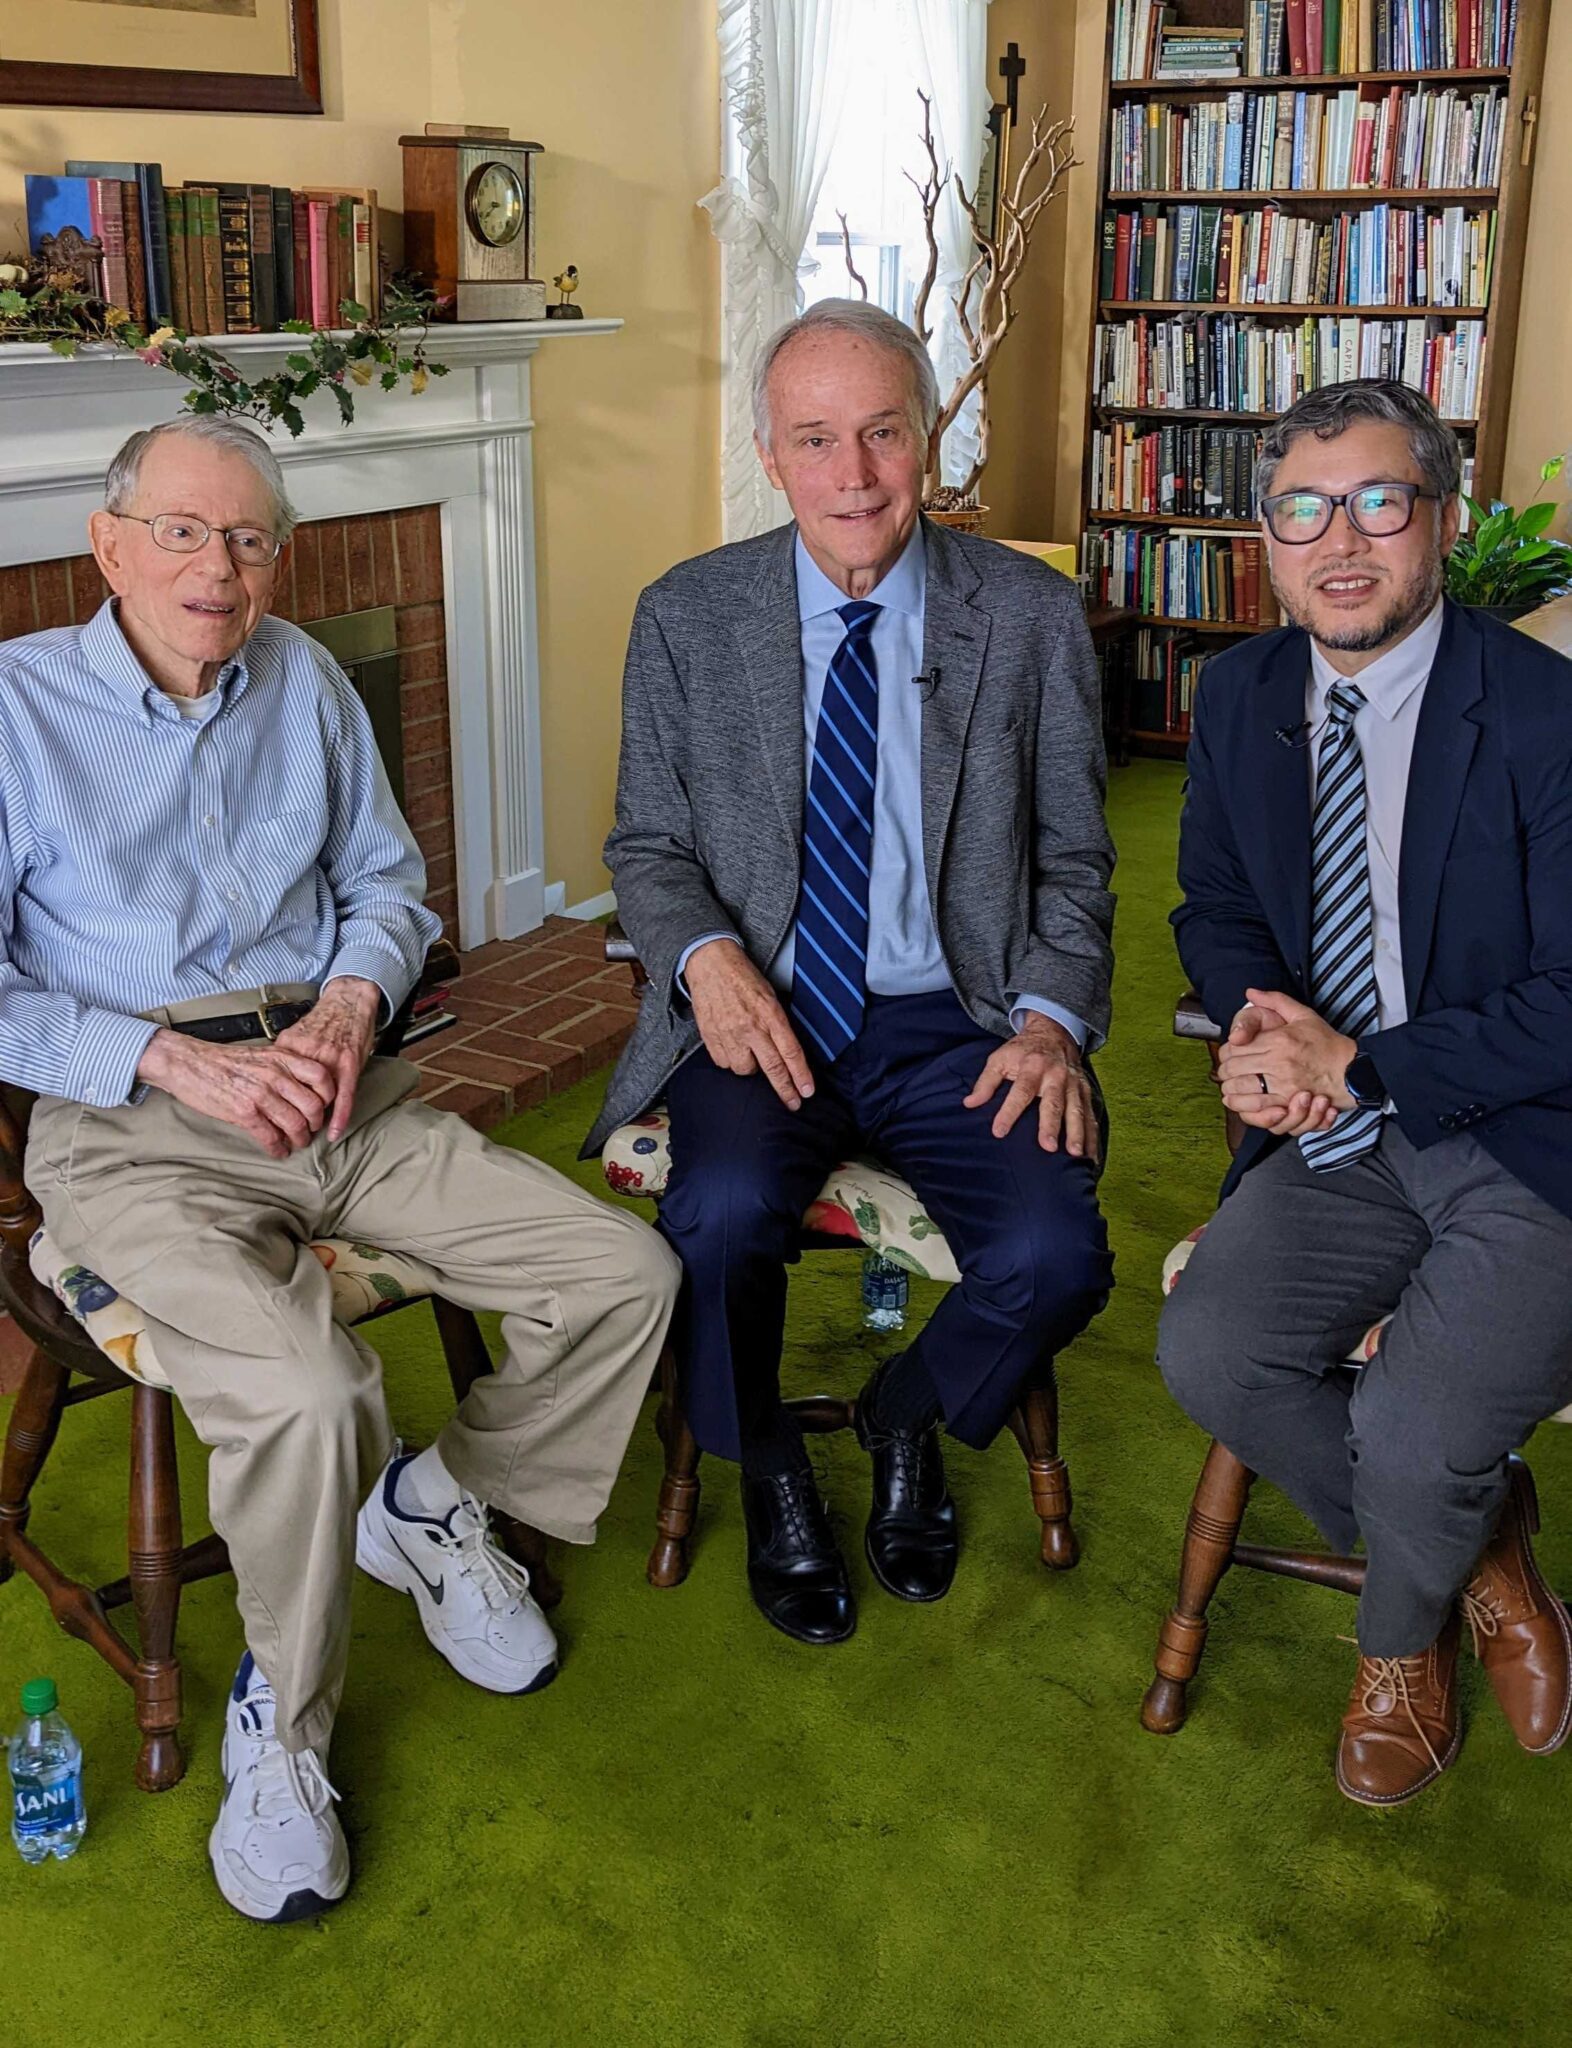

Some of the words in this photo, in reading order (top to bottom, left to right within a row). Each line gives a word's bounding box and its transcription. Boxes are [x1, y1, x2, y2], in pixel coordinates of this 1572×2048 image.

[1243, 147, 1252, 180] METAXAS
[1179, 217, 1192, 261] BIBLE
[1203, 226, 1213, 267] DICTIONARY
[1343, 339, 1353, 382] CAPITAL
